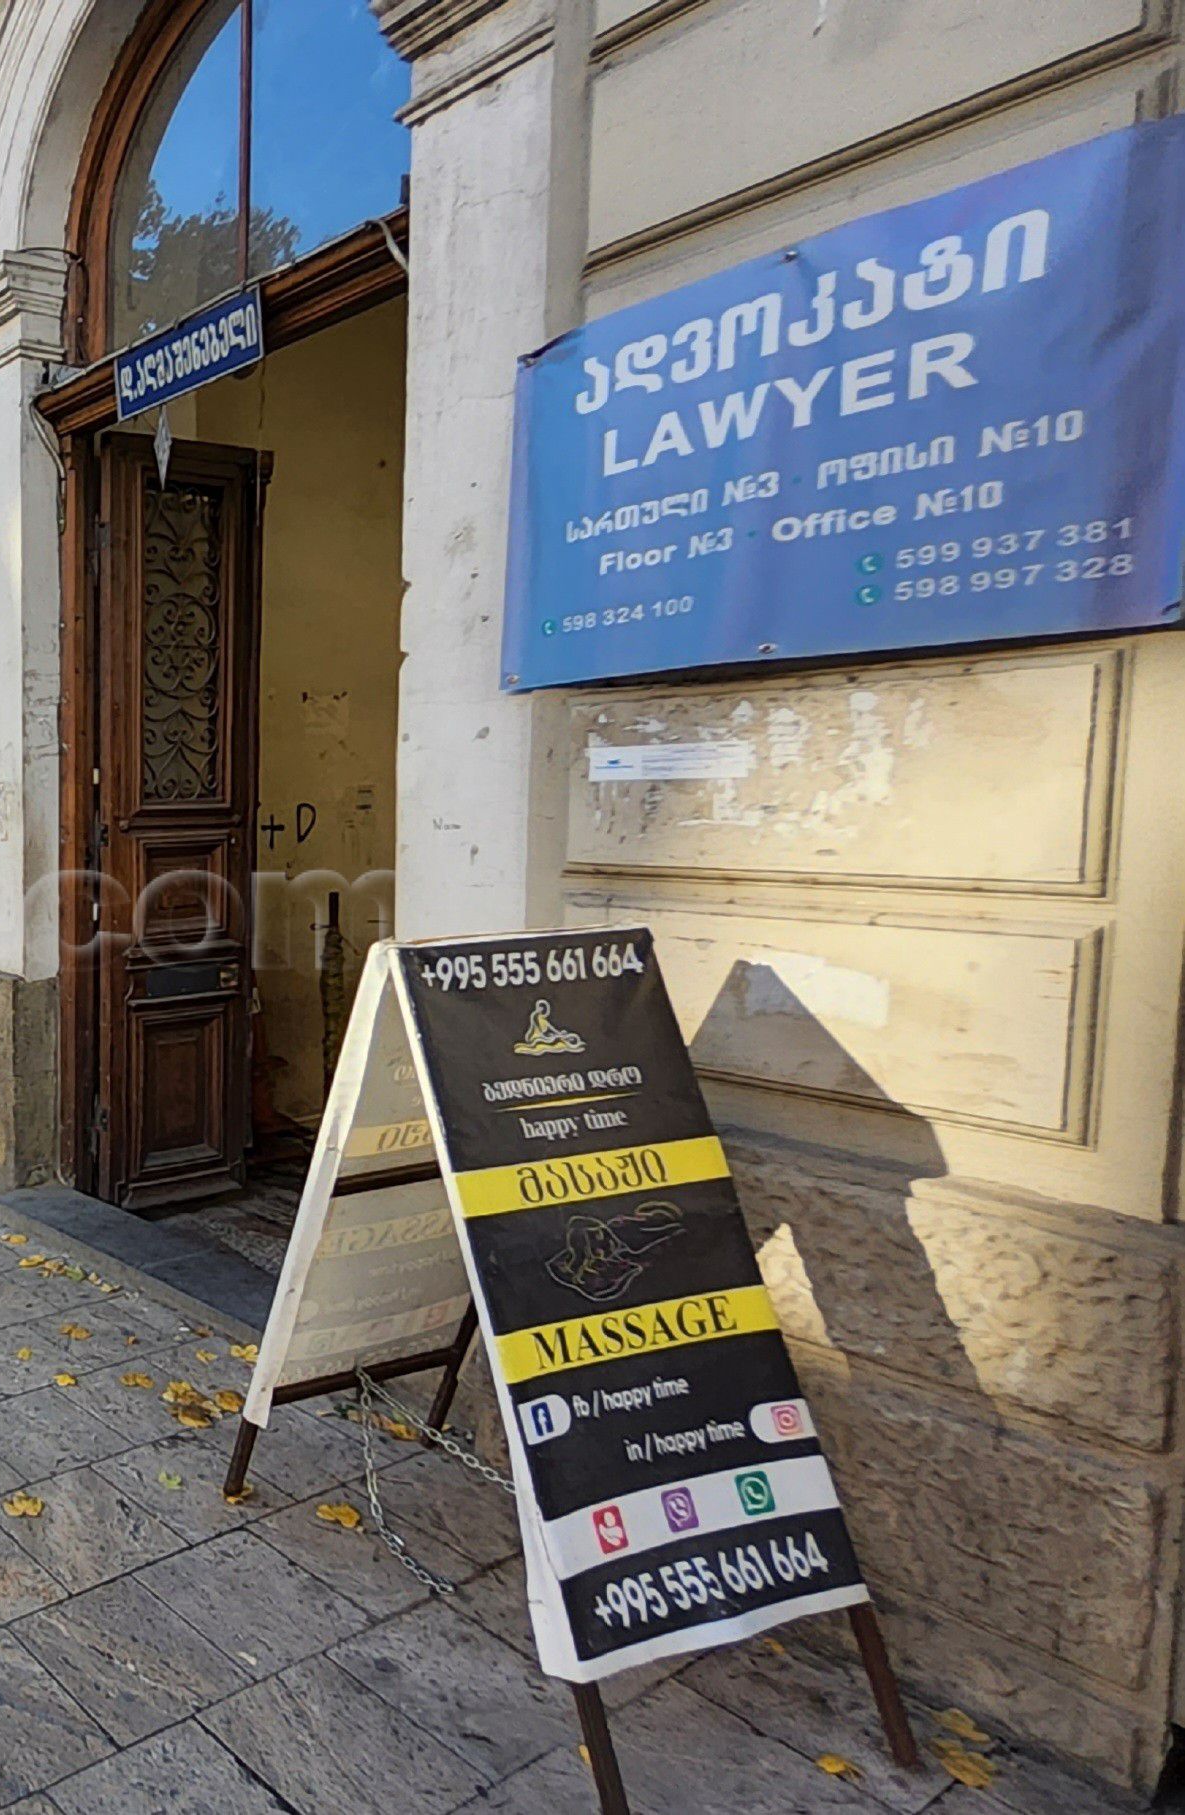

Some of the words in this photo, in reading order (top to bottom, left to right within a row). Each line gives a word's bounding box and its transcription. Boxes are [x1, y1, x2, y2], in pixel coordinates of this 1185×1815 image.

[575, 208, 1050, 415] ადვოკატი
[602, 331, 980, 477] LAWYER
[566, 488, 710, 544] სართული
[721, 471, 780, 507] №3
[816, 436, 955, 490] ოფისი
[977, 409, 1085, 458] №10
[599, 545, 678, 576] Floor
[687, 527, 735, 560] №3
[771, 505, 898, 542] Office
[912, 480, 1004, 522] №10
[895, 541, 961, 570] 599
[971, 529, 1045, 558] 937
[1055, 517, 1136, 547] 381
[893, 574, 961, 602] 598
[969, 563, 1045, 593] 997
[1054, 553, 1135, 582] 328
[562, 612, 597, 633] 598
[601, 603, 645, 626] 324
[651, 595, 694, 617] 100
[421, 954, 487, 991] +995
[491, 951, 541, 987] 555
[546, 947, 588, 982] 661
[592, 943, 644, 978] 664
[482, 1072, 586, 1101] ბედნიერი
[587, 1065, 643, 1089] დრო
[519, 1116, 580, 1141] happy
[583, 1109, 630, 1130] time
[516, 1148, 668, 1204] მასაჟი
[532, 1295, 738, 1370] MASSAGE
[572, 1395, 590, 1418] fb
[602, 1384, 653, 1412] happy
[652, 1376, 690, 1399] time
[623, 1438, 643, 1461] in
[655, 1428, 707, 1456] happy
[707, 1419, 746, 1442] time
[594, 1572, 669, 1628] +995
[658, 1557, 727, 1610] 555
[718, 1545, 776, 1595] 661
[769, 1531, 829, 1583] 664
